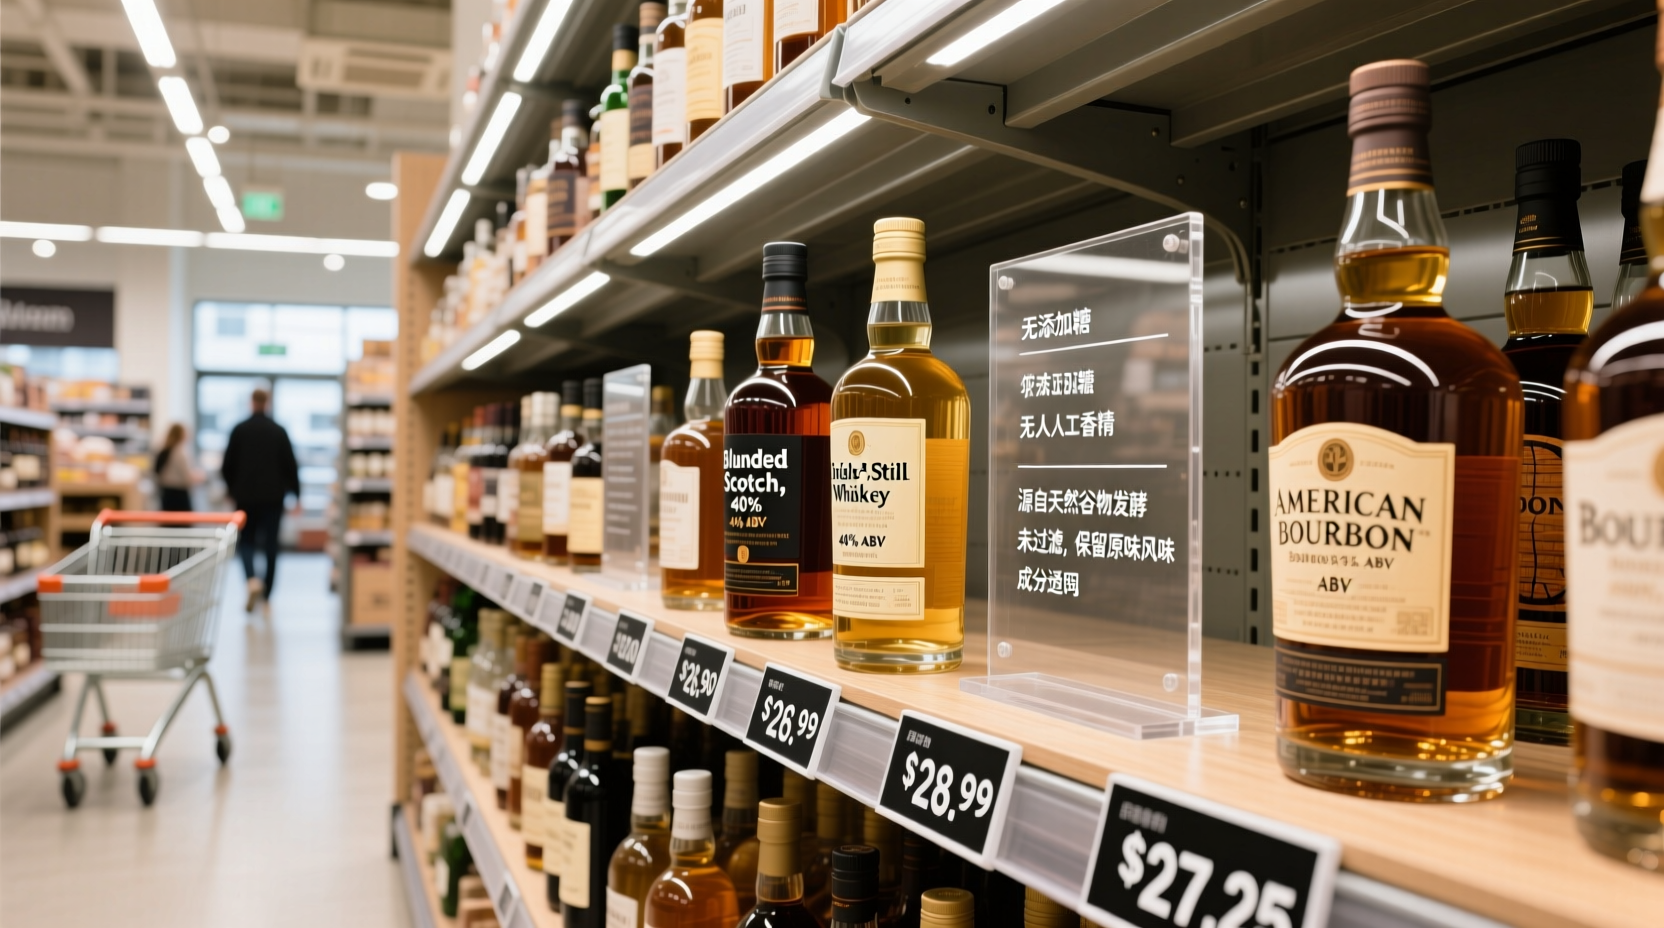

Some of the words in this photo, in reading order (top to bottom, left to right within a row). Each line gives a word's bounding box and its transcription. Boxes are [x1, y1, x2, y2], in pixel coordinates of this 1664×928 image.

[1021, 307, 1092, 341] 无添加糖
[1019, 409, 1115, 439] 无人人工香精
[723, 471, 786, 497] Scotch,
[730, 495, 763, 513] 40%
[1017, 486, 1148, 518] 源自天然谷物发酵
[1274, 487, 1426, 524] AMERICAN
[860, 535, 886, 548] ABV
[1278, 520, 1415, 552] BOURBON
[1363, 556, 1395, 570] ABV
[1317, 576, 1353, 593] ABV
[761, 694, 819, 746] $26.99
[901, 750, 994, 822] $28.99
